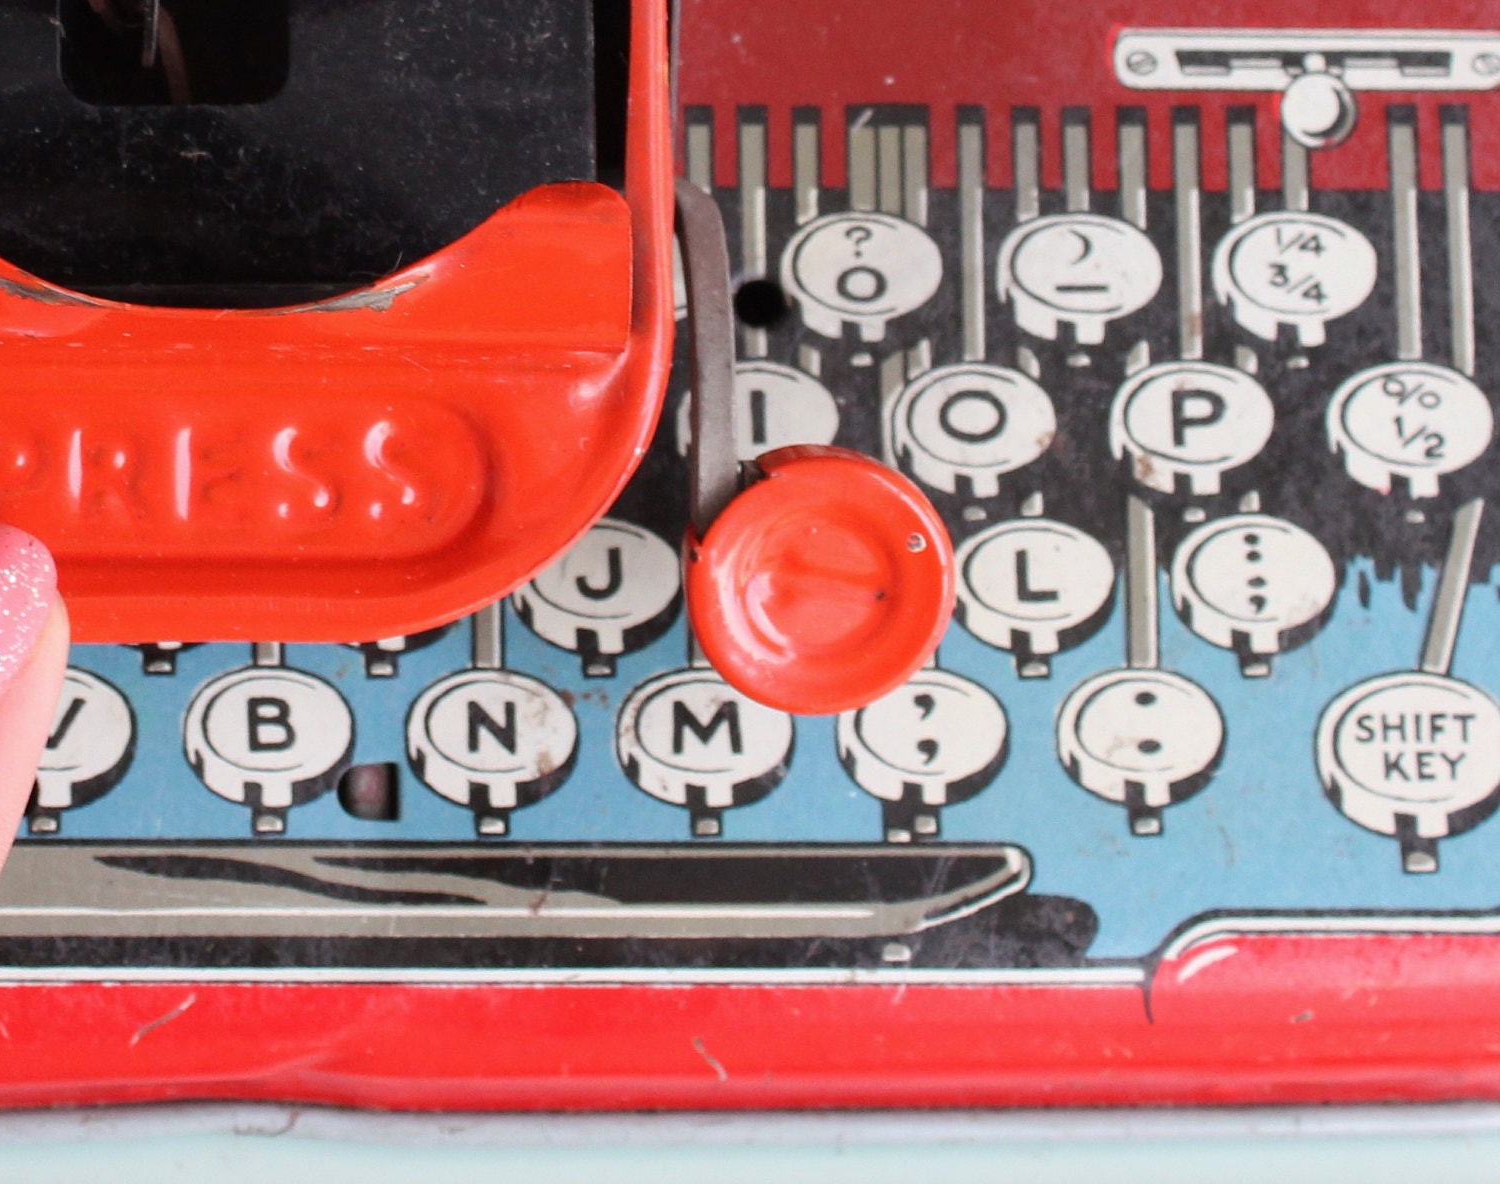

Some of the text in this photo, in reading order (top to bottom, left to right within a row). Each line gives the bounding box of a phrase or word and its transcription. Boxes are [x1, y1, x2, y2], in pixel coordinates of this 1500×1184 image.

[845, 226, 872, 258] ?
[751, 390, 766, 444] I
[939, 390, 1006, 443] O
[1172, 389, 1225, 446] P
[576, 547, 622, 600] J
[1016, 550, 1058, 602] L
[247, 697, 295, 752] B
[468, 701, 516, 754] N
[673, 701, 741, 754] M
[1357, 713, 1475, 742] SHIFT
[1384, 752, 1464, 780] KEY
